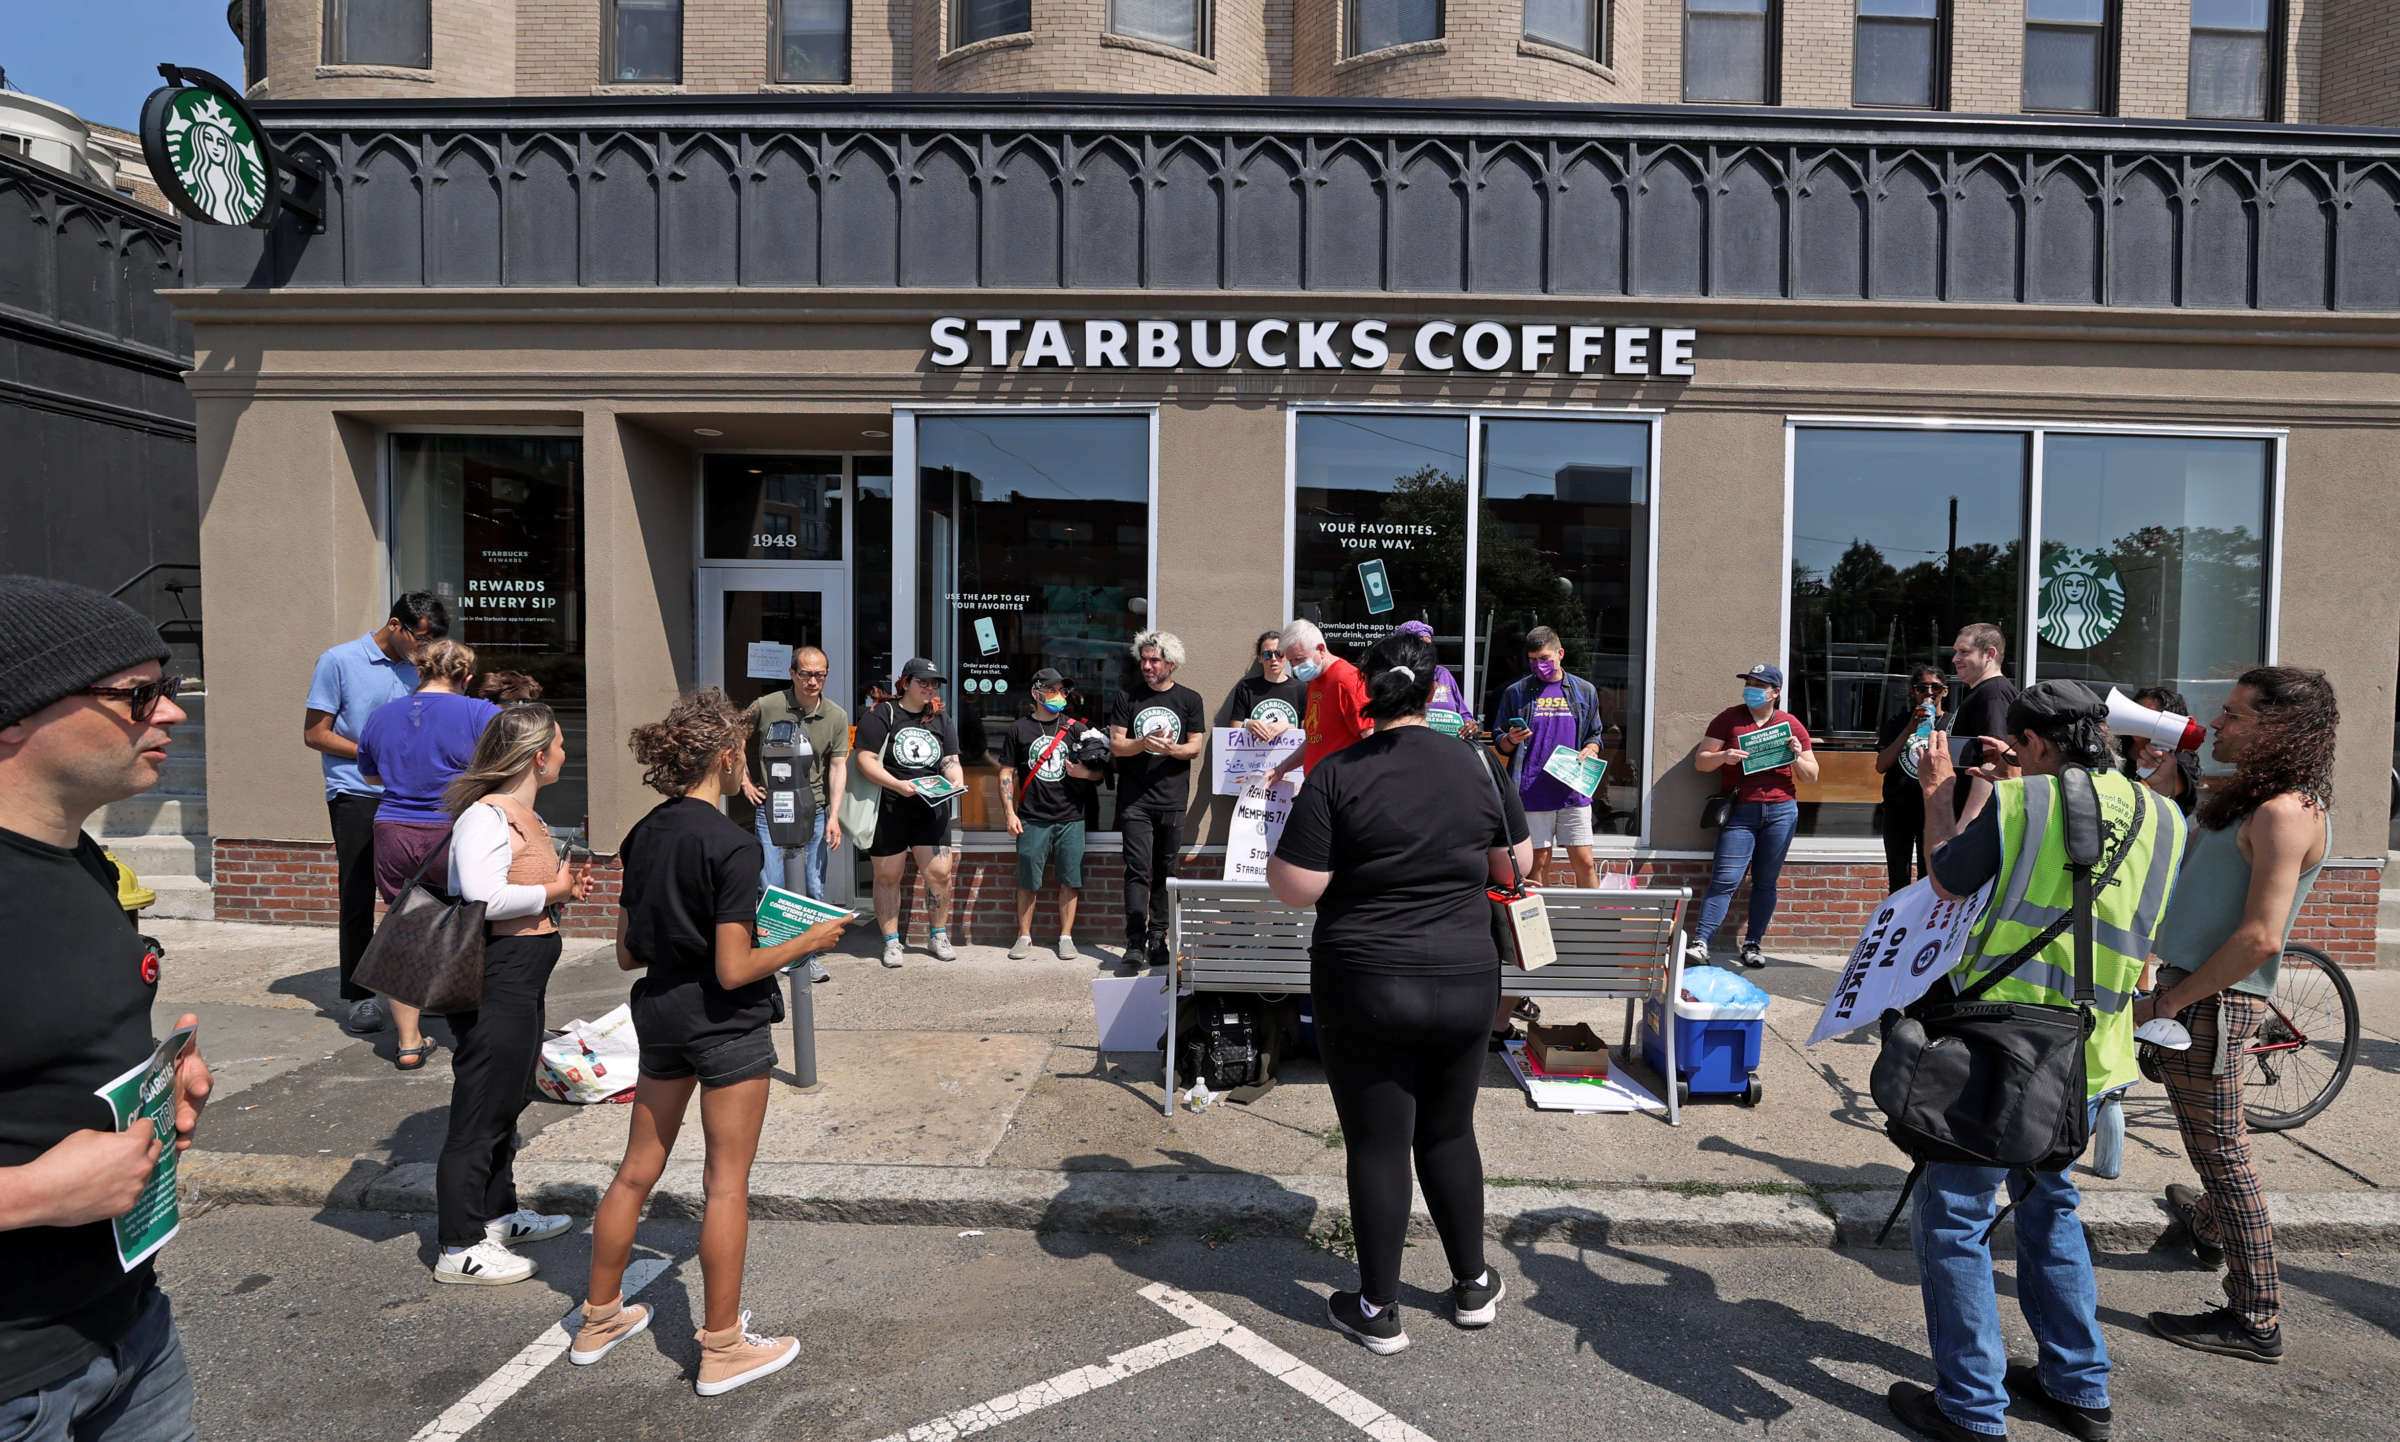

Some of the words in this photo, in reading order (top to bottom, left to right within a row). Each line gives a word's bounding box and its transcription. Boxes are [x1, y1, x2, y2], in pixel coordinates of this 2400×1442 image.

[929, 316, 1390, 370] STARBUCKS
[1414, 319, 1697, 377] COFFEE
[1319, 522, 1356, 534] YOUR
[1360, 523, 1437, 536] FAVORITES.
[752, 534, 797, 547] 1948
[1340, 538, 1377, 549] YOUR
[1381, 539, 1415, 550] WAY.
[469, 580, 545, 592] REWARDS
[458, 597, 474, 608] IN
[480, 597, 527, 608] EVERY
[532, 597, 556, 609] SIP
[978, 602, 1024, 611] FAVORITES
[1318, 621, 1355, 630] Download
[1356, 622, 1369, 630] the
[1370, 624, 1384, 632] app
[1342, 631, 1364, 639] drink,
[970, 668, 982, 676] Easy
[989, 662, 1001, 670] pick
[1246, 784, 1278, 801] REHIRE
[1238, 804, 1273, 823] MEMPHIS
[1274, 811, 1286, 825] 7!
[1249, 848, 1270, 860] STOP
[1235, 863, 1267, 876] STARBUC
[1878, 927, 1907, 968] ON
[1834, 907, 1895, 1020] STRIKE!
